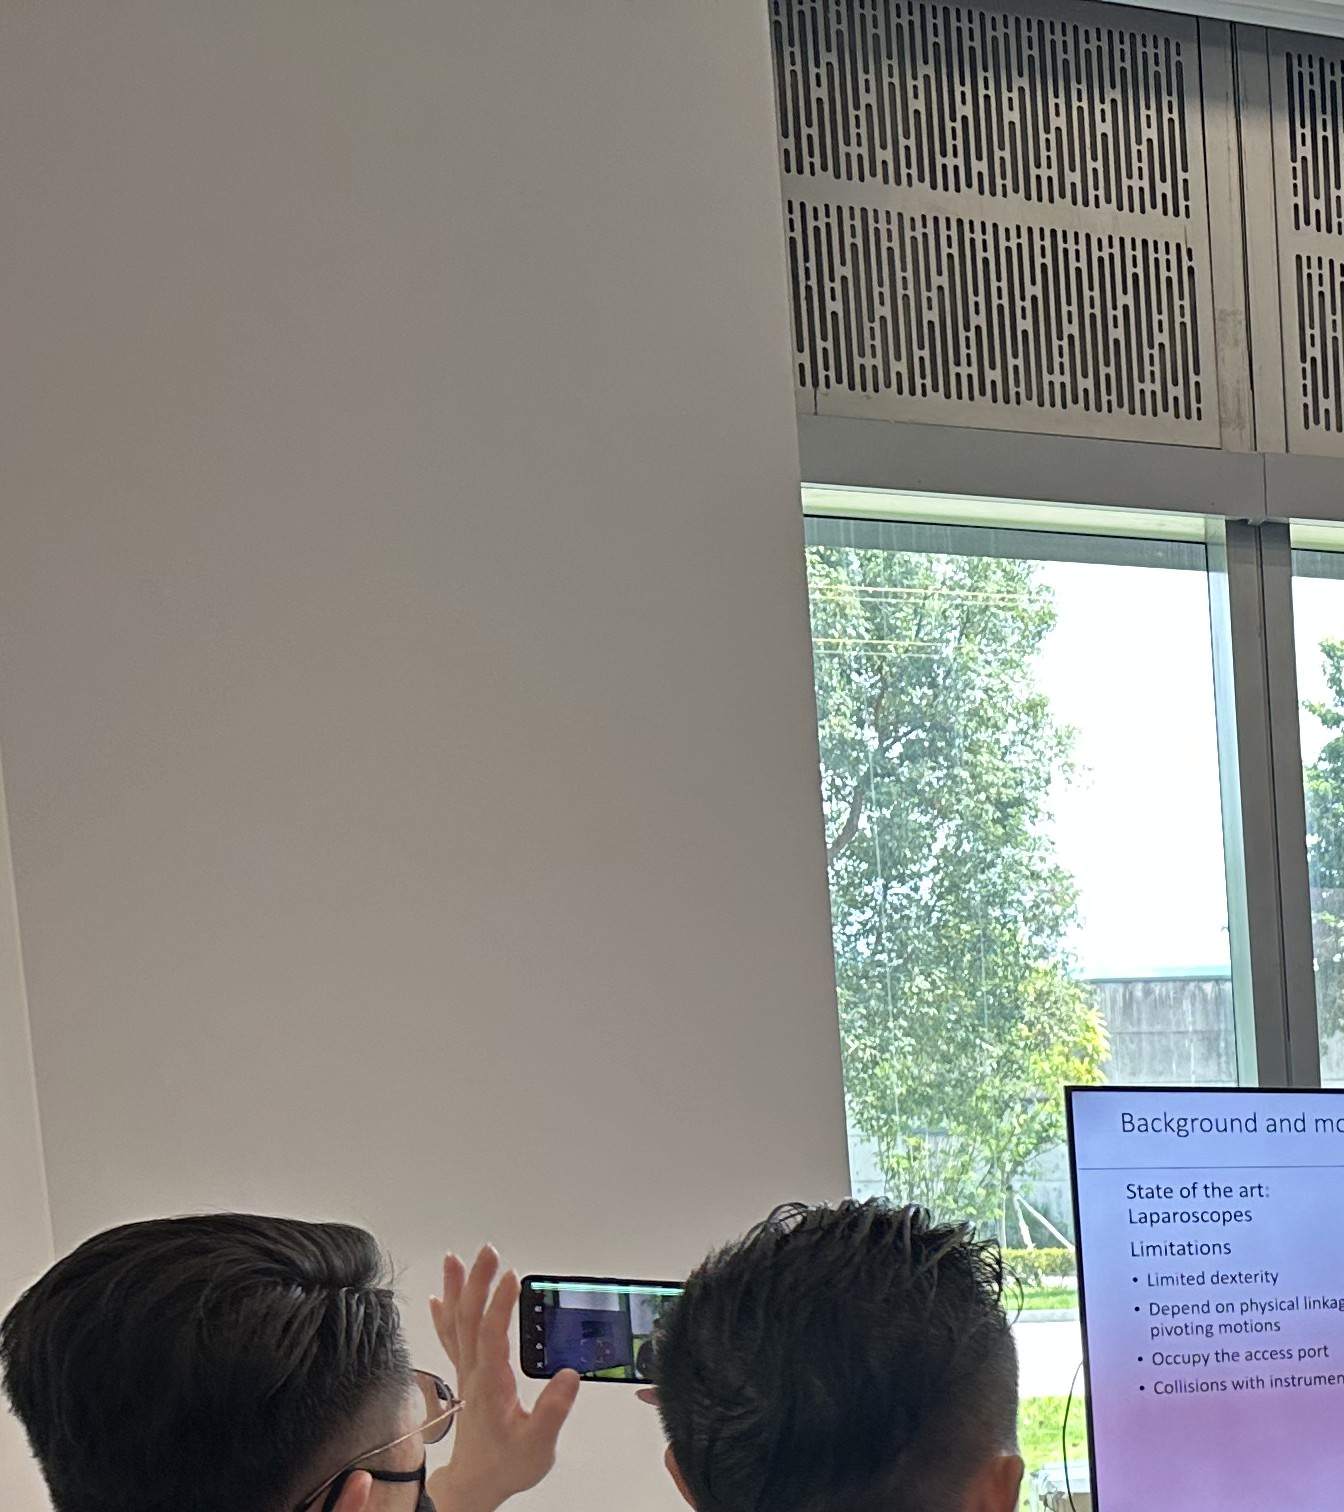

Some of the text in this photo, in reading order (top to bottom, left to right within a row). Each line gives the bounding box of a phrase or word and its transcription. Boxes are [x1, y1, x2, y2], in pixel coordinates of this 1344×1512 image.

[1121, 1112, 1257, 1138] Background
[1266, 1112, 1306, 1133] and
[1126, 1182, 1270, 1200] State of the art:
[1128, 1208, 1253, 1227] Laparoscopes
[1130, 1240, 1232, 1257] Limitations
[1147, 1270, 1279, 1287] Limited dexterity
[1149, 1300, 1210, 1318] Depend
[1215, 1301, 1235, 1313] on
[1240, 1297, 1299, 1315] physical
[1150, 1320, 1281, 1340] pivoting motions
[1152, 1345, 1329, 1367] Occupy the access port
[1153, 1377, 1228, 1395] Collisions
[1232, 1375, 1265, 1390] with
